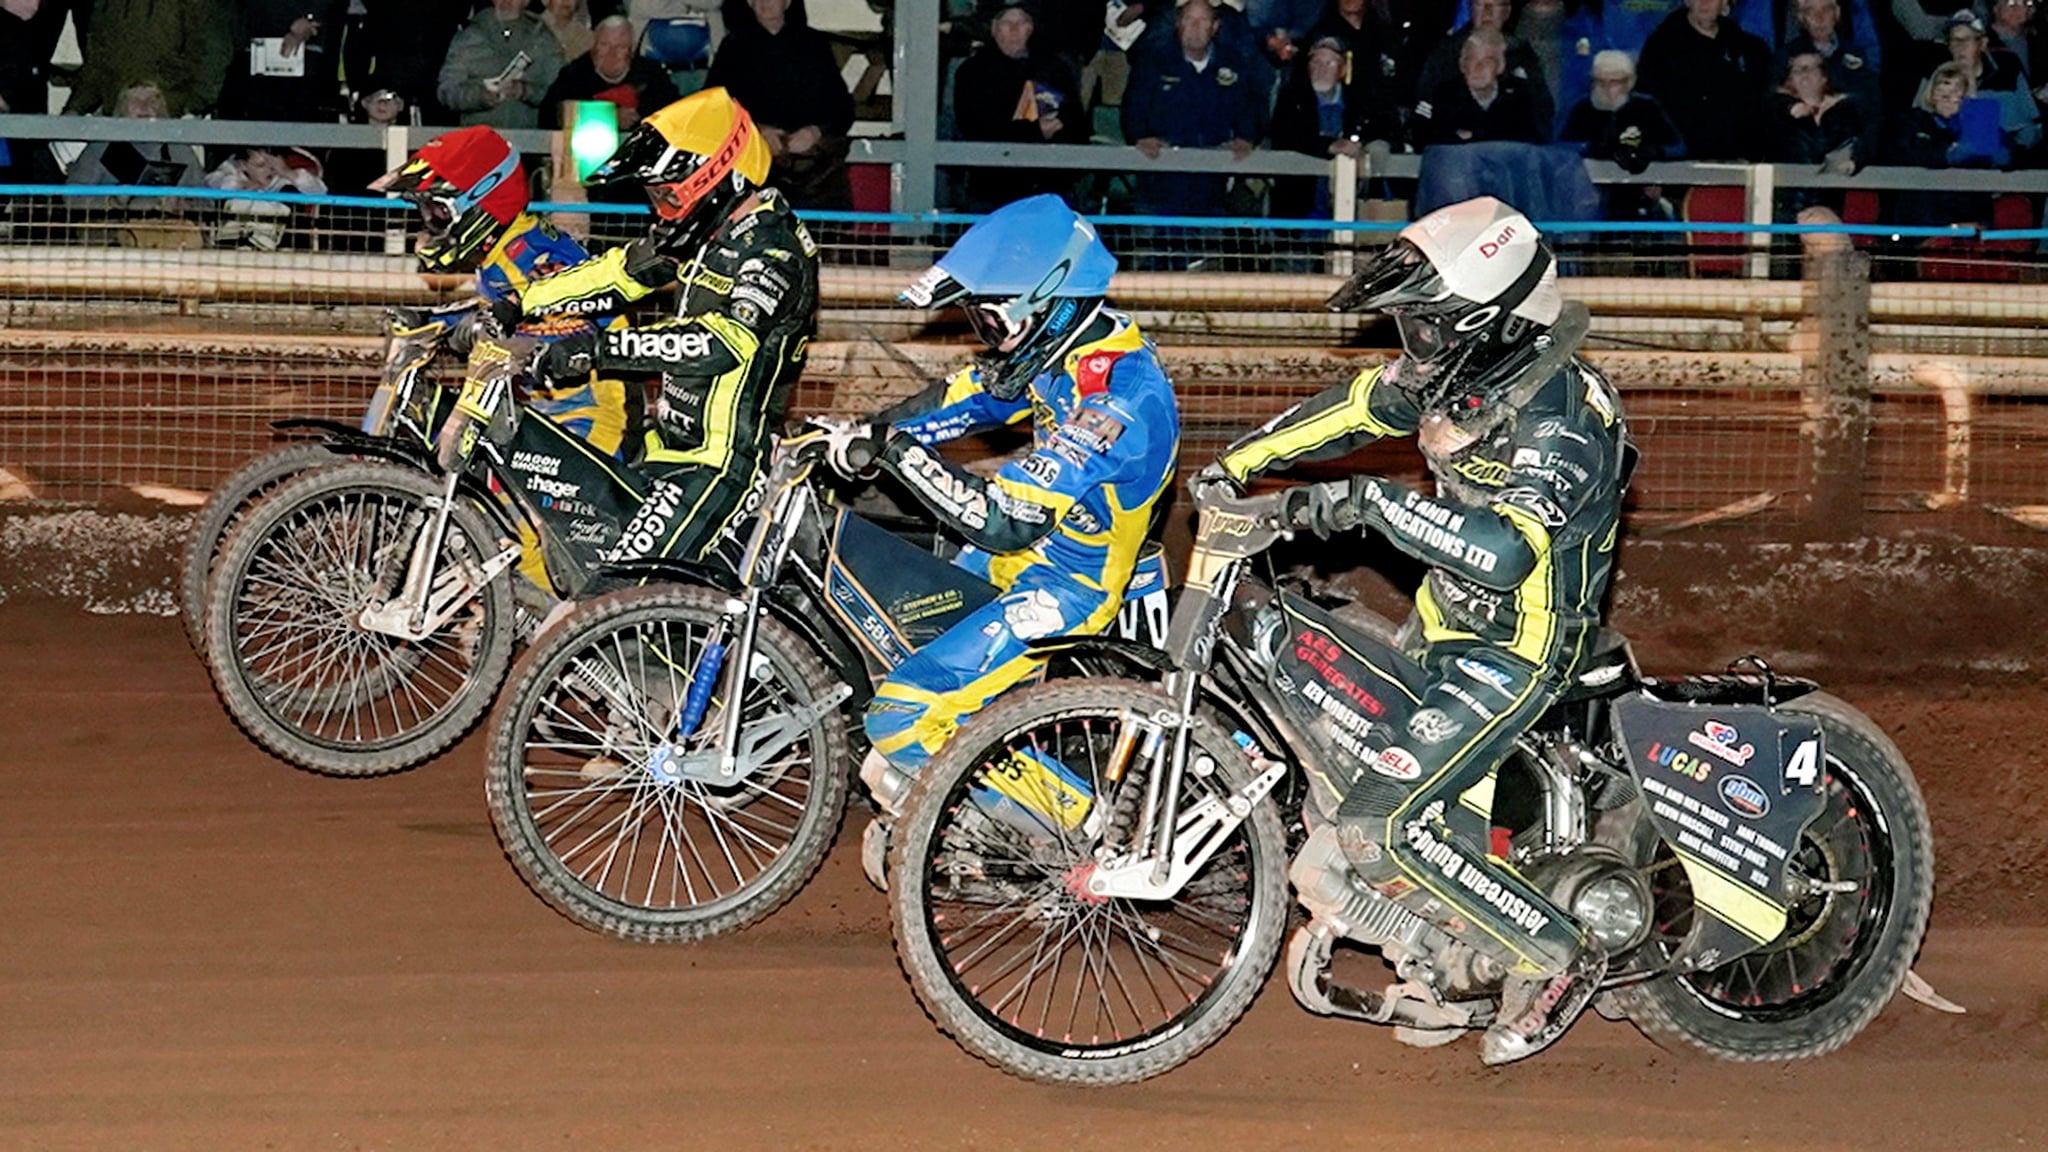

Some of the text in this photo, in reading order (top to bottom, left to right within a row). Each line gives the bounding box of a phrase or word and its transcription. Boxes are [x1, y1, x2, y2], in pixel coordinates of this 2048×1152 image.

[693, 121, 747, 193] SCOTT
[1479, 225, 1516, 259] Dan
[510, 460, 559, 476] SHOCKS
[512, 451, 561, 467] HAGON
[1464, 544, 1497, 572] LTD
[1321, 694, 1373, 738] ROBERTS
[1648, 743, 1712, 782] LUCAS
[1786, 740, 1817, 786] 4
[1458, 862, 1549, 936] Jetstream
